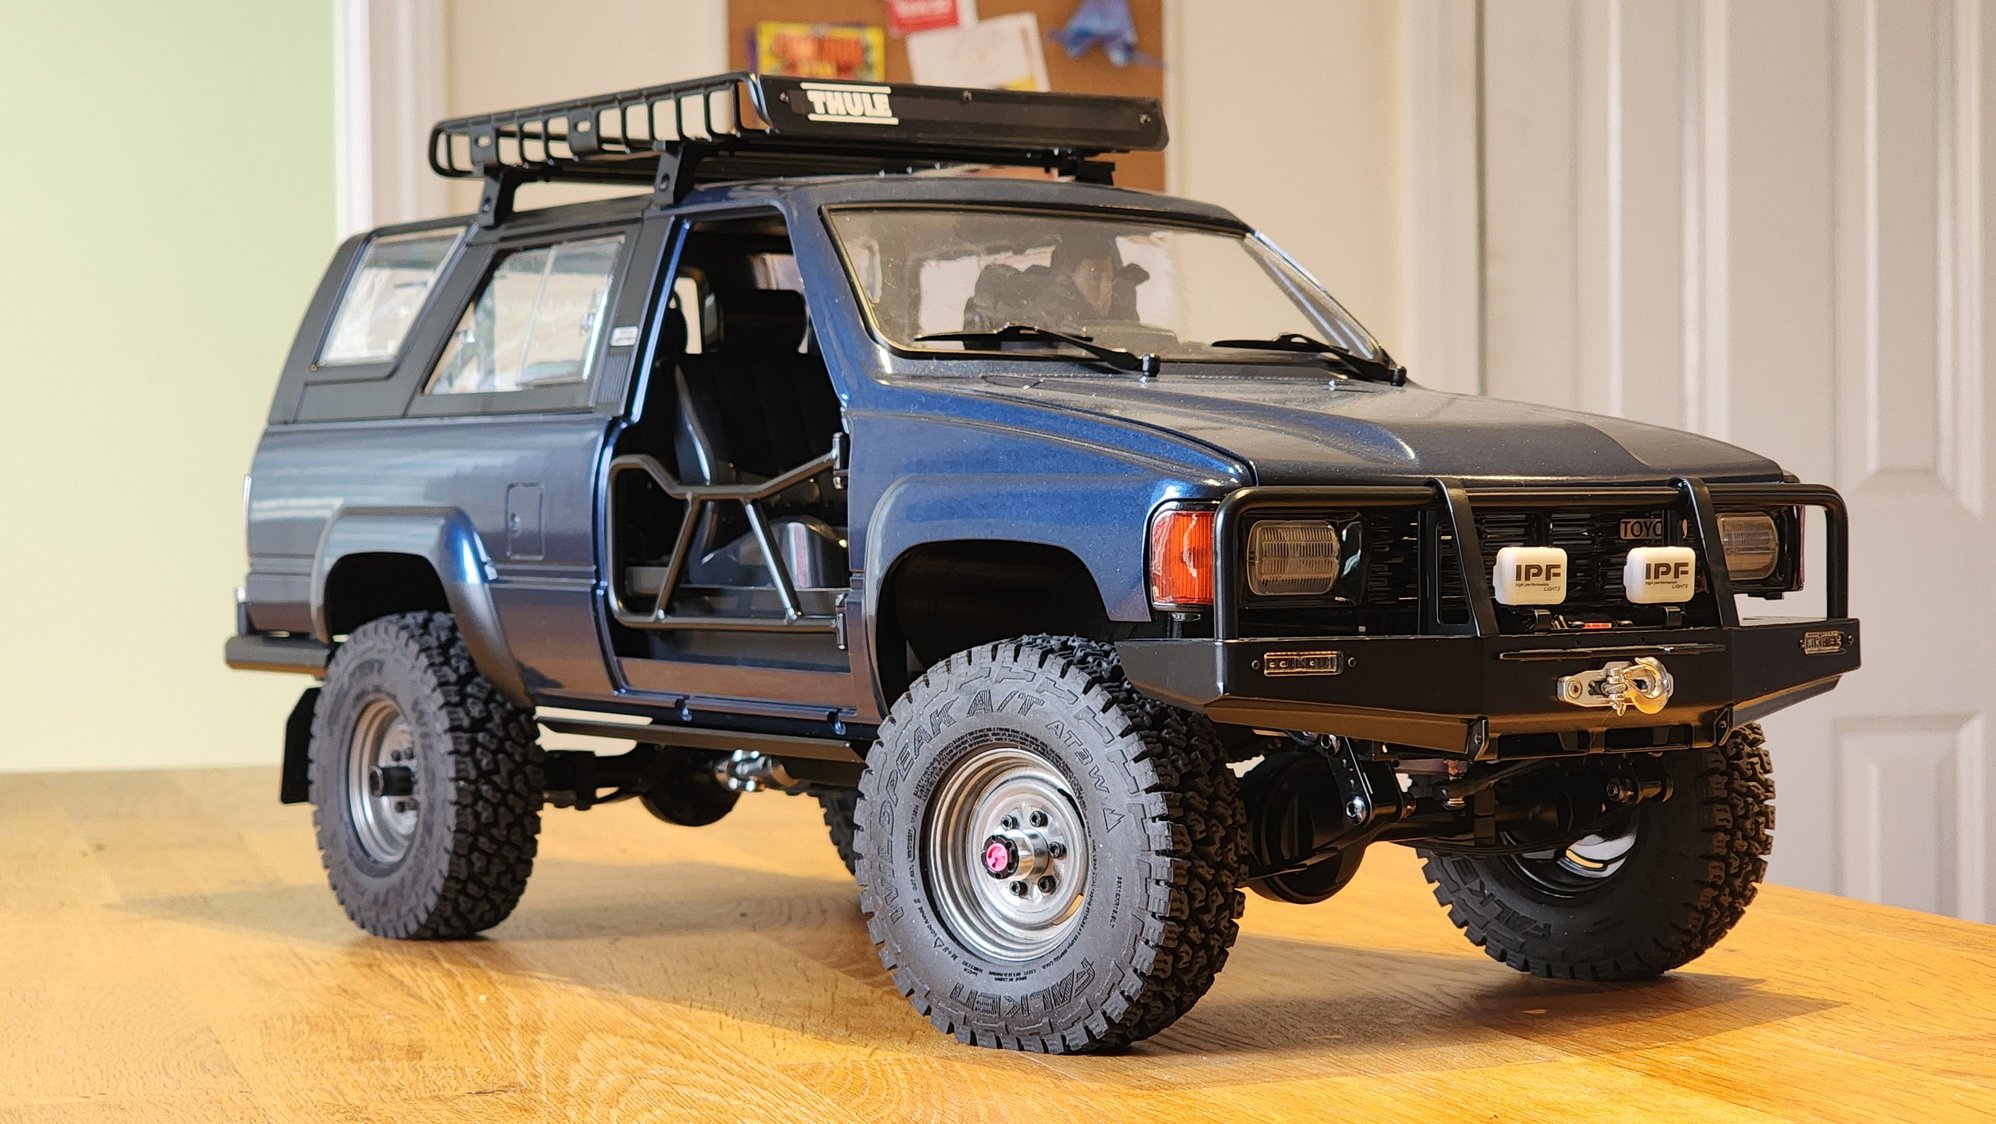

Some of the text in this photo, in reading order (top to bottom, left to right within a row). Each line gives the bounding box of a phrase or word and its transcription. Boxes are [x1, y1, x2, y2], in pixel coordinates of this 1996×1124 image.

[806, 90, 892, 117] THULE
[1621, 520, 1663, 538] TOYO
[1515, 564, 1562, 581] IPF
[1645, 562, 1690, 580] IPF
[877, 695, 960, 923] WILDPEAK
[966, 688, 1045, 718] A/T
[950, 957, 1096, 1017] FALKEN
